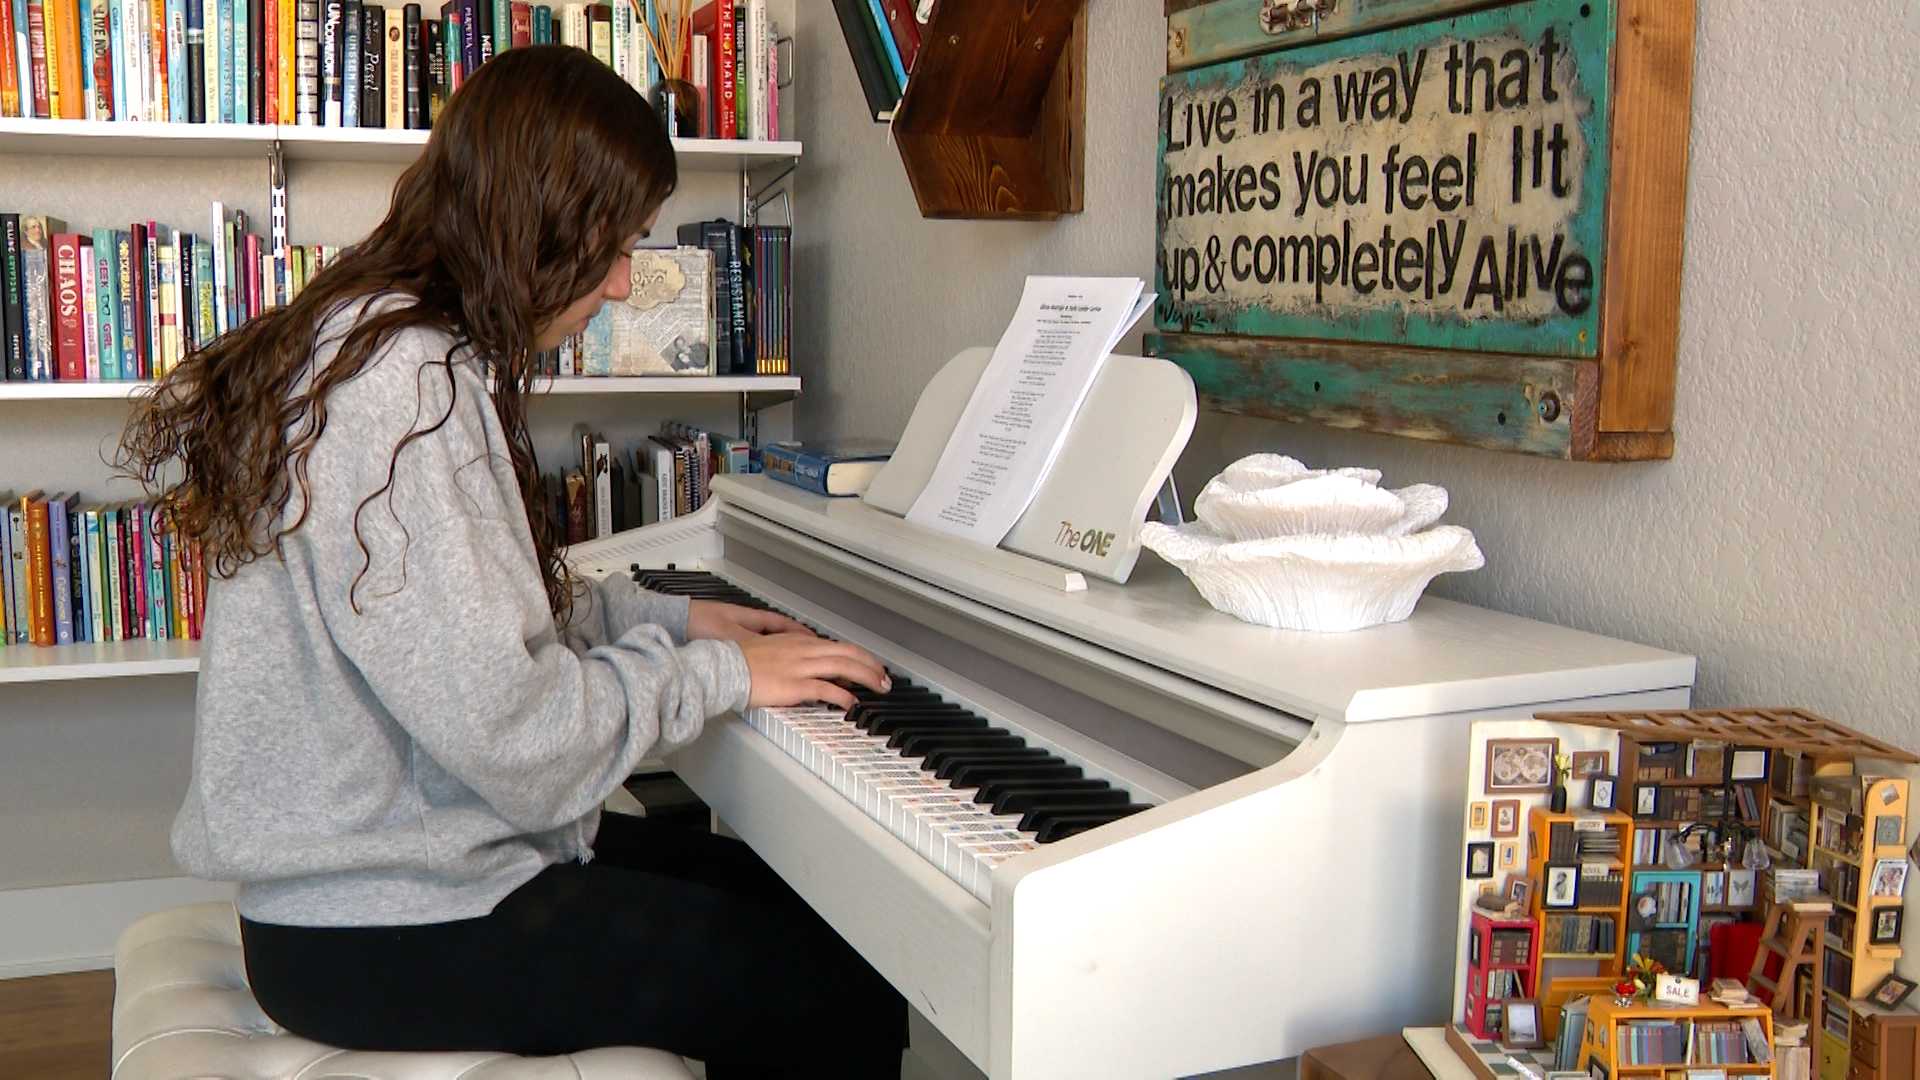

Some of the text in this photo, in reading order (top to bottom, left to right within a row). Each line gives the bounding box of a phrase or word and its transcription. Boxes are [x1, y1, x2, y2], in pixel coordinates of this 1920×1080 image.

[93, 8, 105, 36] LIVE
[94, 38, 105, 62] NOT
[481, 34, 492, 64] MEL
[722, 2, 733, 101] THE HOT HAND
[363, 50, 380, 92] Paul
[1165, 26, 1560, 152] Live in a way that
[1166, 122, 1572, 219] makes you feel lit
[58, 244, 78, 317] CHAOS
[99, 258, 112, 350] GEEK GIRL
[729, 260, 745, 334] RESISTANCE
[1162, 218, 1595, 317] up & completely Alive
[1055, 521, 1116, 557] The ONE
[1665, 985, 1690, 998] SALE
